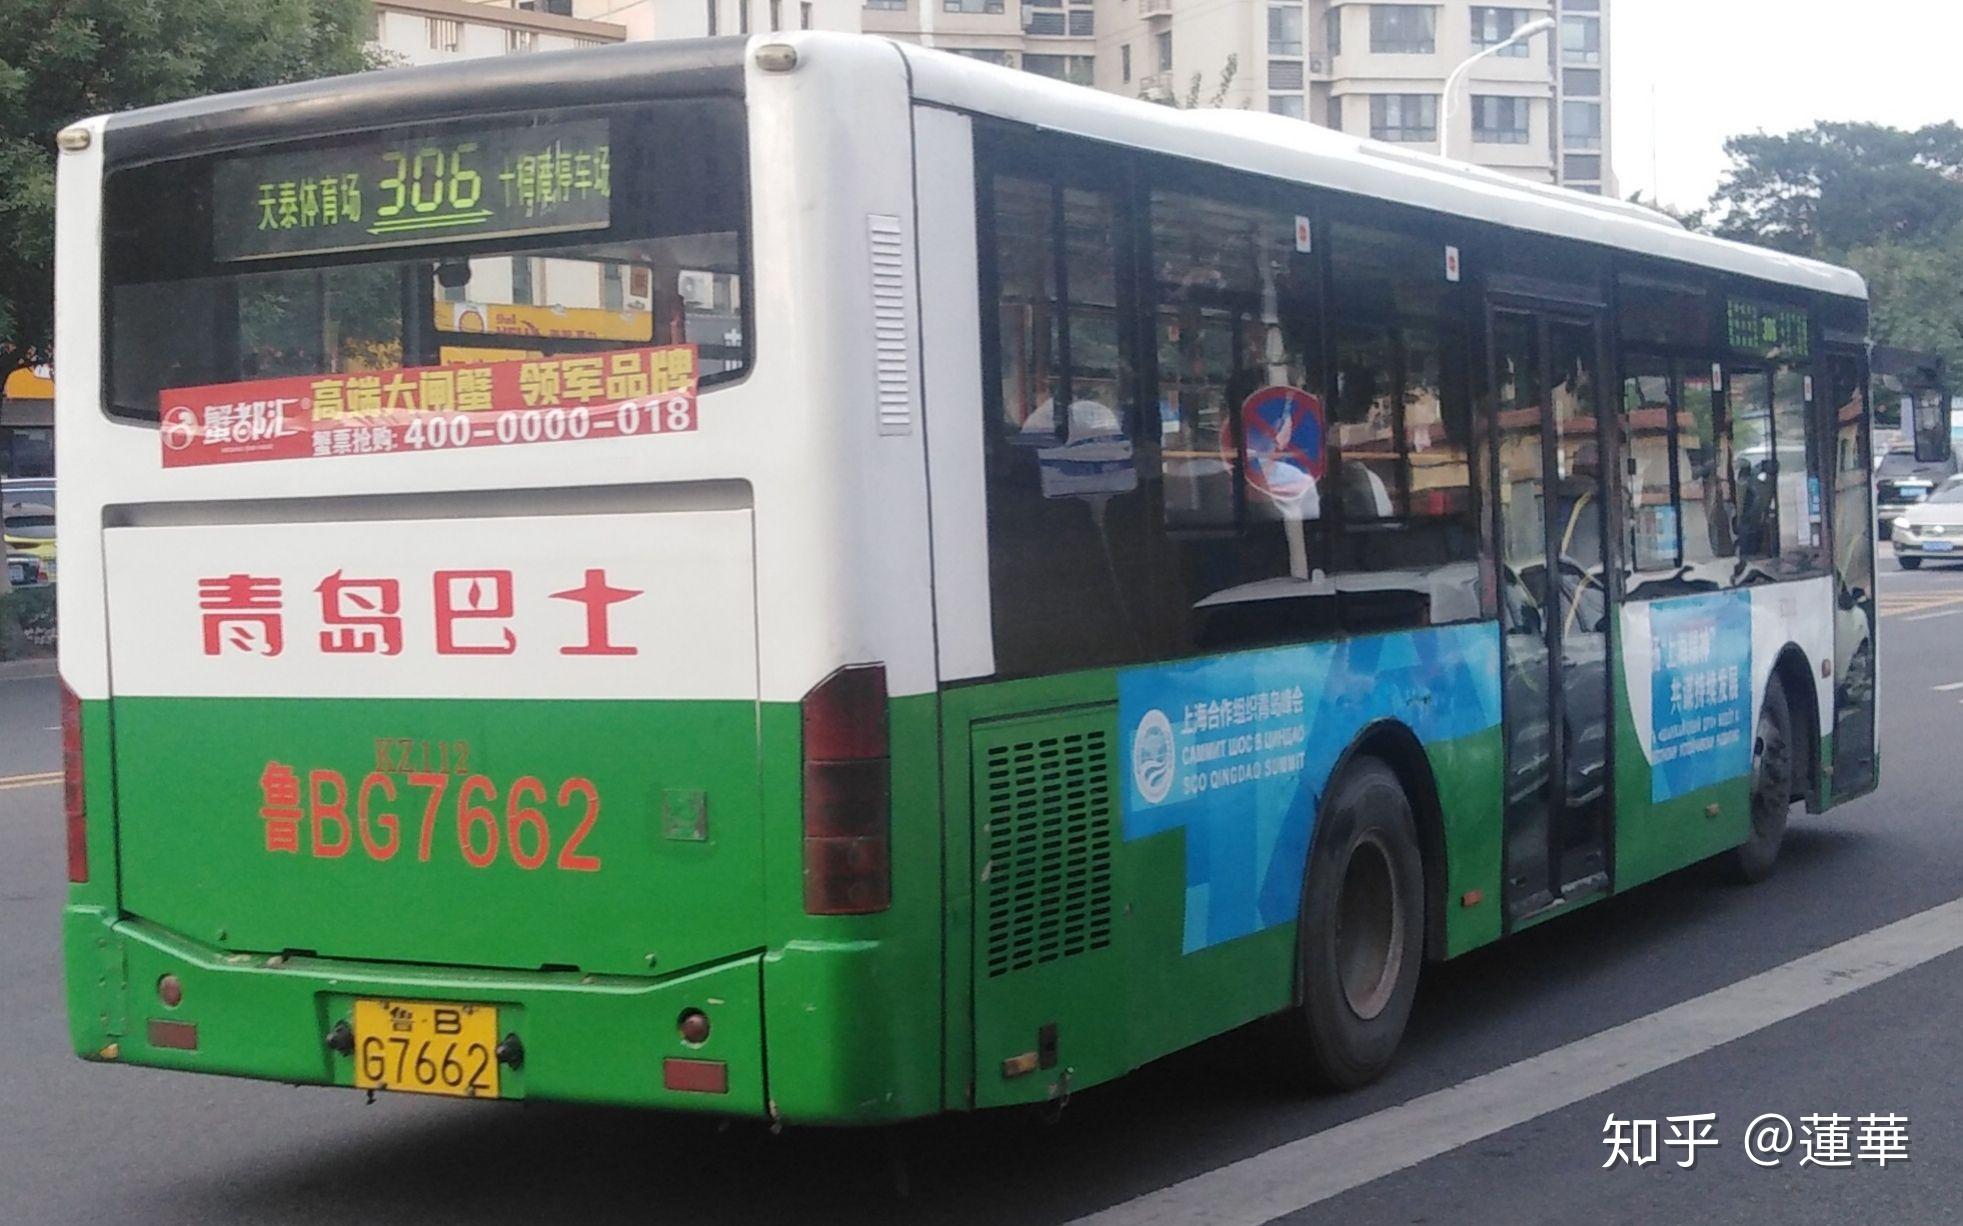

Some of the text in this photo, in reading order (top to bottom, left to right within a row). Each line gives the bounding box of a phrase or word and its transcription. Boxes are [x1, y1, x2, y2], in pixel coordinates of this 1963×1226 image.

[258, 173, 362, 231] 天泰体育场
[377, 142, 482, 217] 306
[311, 348, 693, 422] 高端大闸蟹 领军品牌
[404, 396, 691, 450] 400-0000-018
[197, 568, 646, 657] 青岛巴士
[374, 738, 472, 775] KZ112
[1210, 761, 1262, 789] QINGDAO
[260, 759, 602, 872] 鲁BG7662
[363, 1036, 490, 1090] G7662
